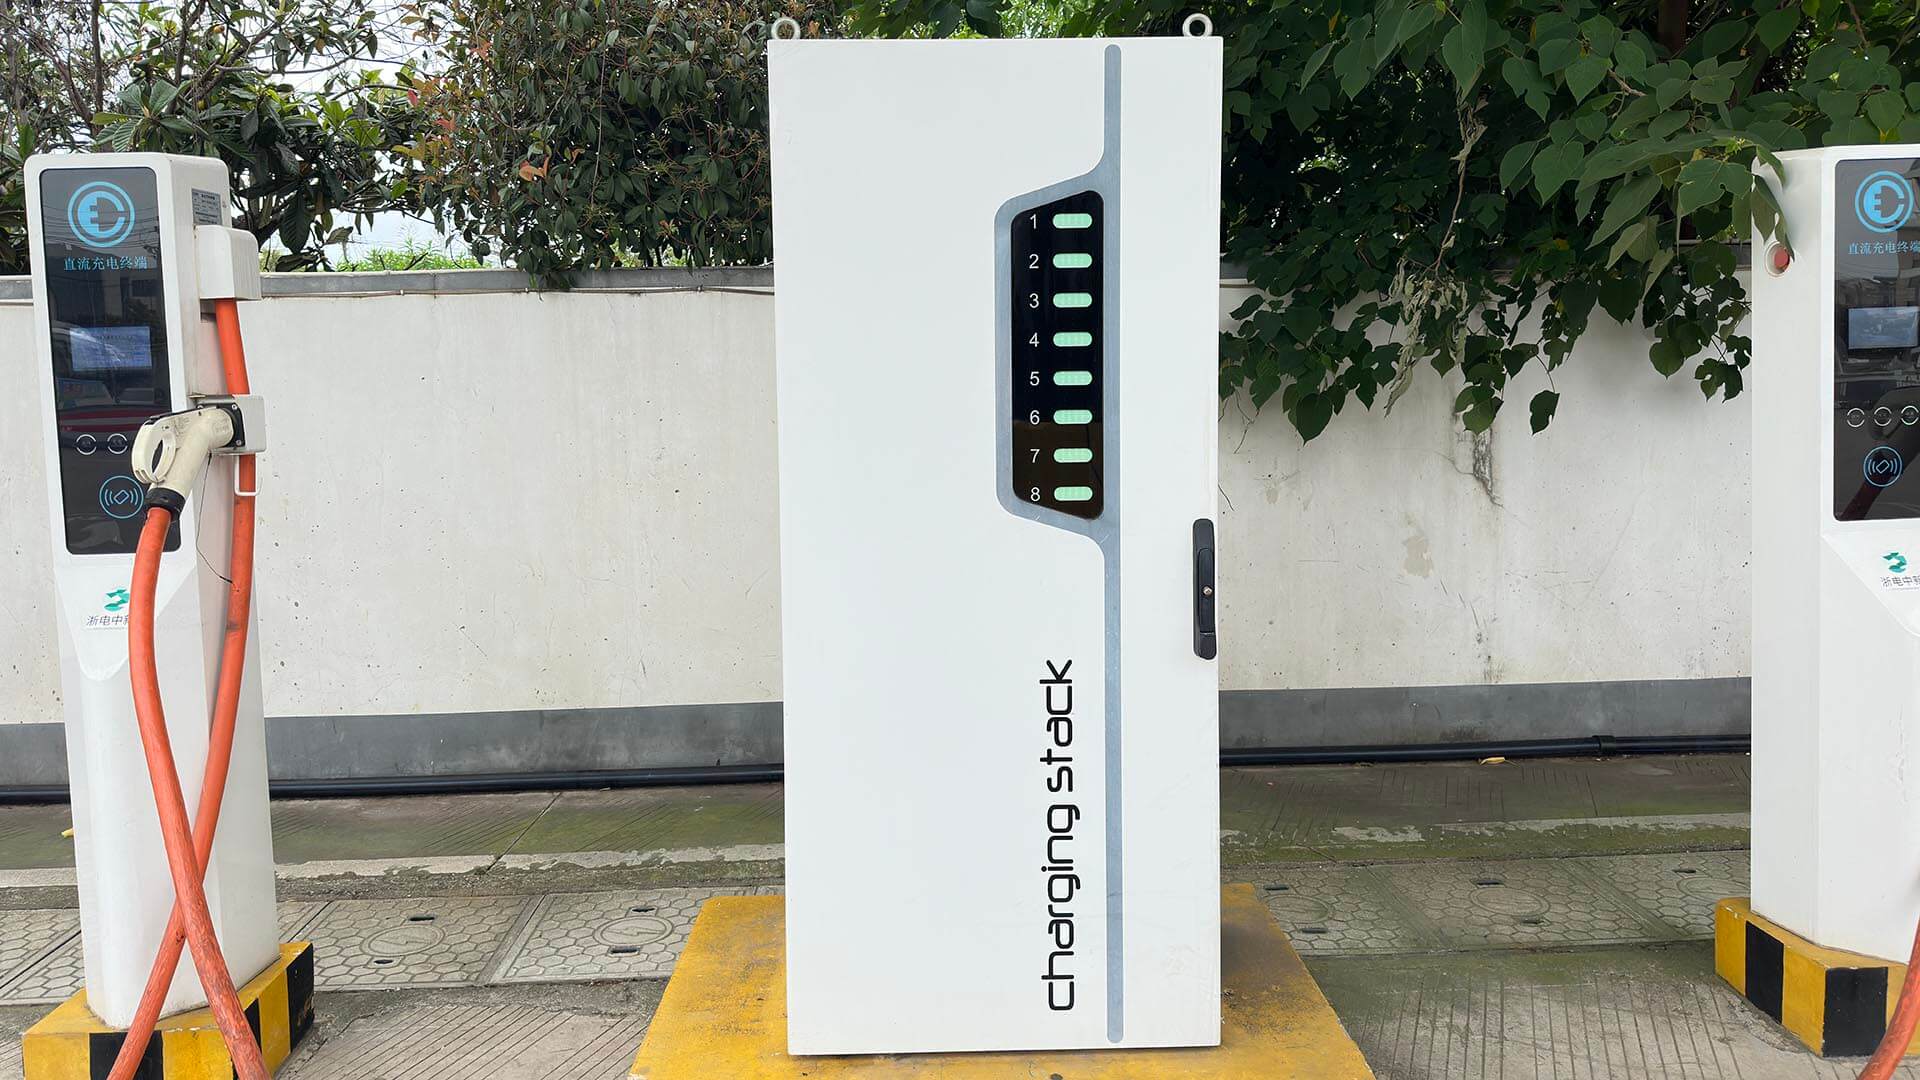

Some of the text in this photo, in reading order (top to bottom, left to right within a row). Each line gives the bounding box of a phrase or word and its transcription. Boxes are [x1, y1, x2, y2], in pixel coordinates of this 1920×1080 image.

[1030, 214, 1037, 229] 1
[1848, 241, 1920, 255] 直流充电终端
[64, 256, 147, 270] 直流充电终端
[1029, 254, 1038, 269] 2
[1029, 293, 1039, 308] 3
[1029, 333, 1039, 348] 4
[1030, 371, 1039, 386] 5
[1030, 410, 1039, 425] 6
[1031, 448, 1040, 463] 7
[1030, 487, 1040, 502] 8
[1039, 659, 1080, 1011] charging stack
